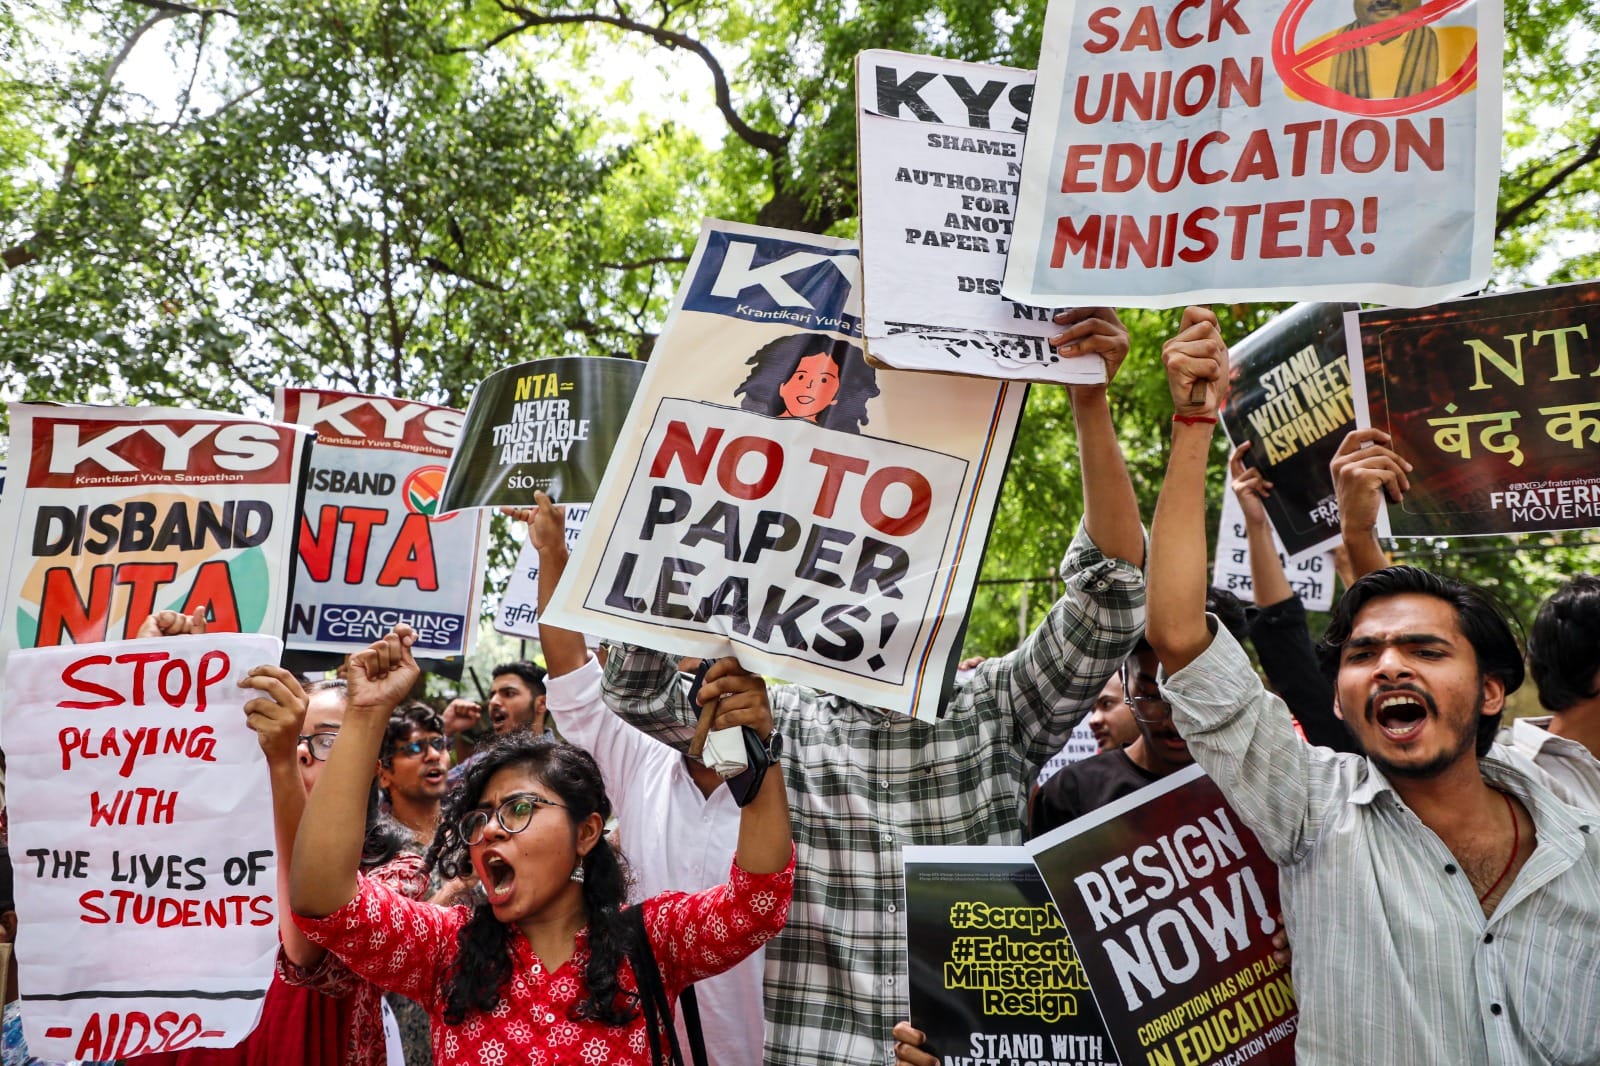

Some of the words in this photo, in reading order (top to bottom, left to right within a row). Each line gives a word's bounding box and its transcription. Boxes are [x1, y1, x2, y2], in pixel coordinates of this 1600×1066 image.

[1083, 0, 1250, 54] SACK
[1074, 56, 1264, 124] UNION
[927, 133, 1016, 157] SHAME
[1060, 118, 1444, 193] EDUCATION
[961, 195, 1010, 215] FOR
[905, 228, 989, 253] PAPER
[1049, 196, 1378, 269] MINISTER!
[957, 275, 1003, 295] DIS
[736, 304, 810, 324] Krantikari
[815, 316, 850, 329] Yuva
[1259, 344, 1321, 401] STAND
[1463, 323, 1600, 391] NT
[297, 392, 466, 448] KYS
[512, 399, 570, 423] NEVER
[1247, 387, 1303, 437] WITH
[1299, 354, 1352, 408] NEET
[49, 423, 280, 473] KYS
[317, 435, 365, 446] Krantikari
[367, 440, 391, 448] Yuva
[393, 442, 448, 455] Sangathan
[492, 419, 590, 446] TRUSTABLE
[499, 440, 573, 465] AGENCY
[1427, 402, 1525, 467] बंद
[75, 475, 138, 484] Krantikari
[141, 474, 171, 482] Yuva
[175, 474, 244, 483] Sangathan
[648, 420, 785, 500] NO
[809, 447, 933, 537] TO
[32, 500, 273, 556] DISBAND
[300, 505, 439, 591] NTA
[639, 485, 910, 600] PAPER
[35, 561, 243, 648] NTA
[323, 608, 459, 632] COACHING
[605, 552, 900, 673] LEAKS!
[328, 623, 450, 645] CENES
[57, 650, 231, 712] STOP
[58, 725, 217, 777] PLAYING
[90, 787, 178, 828] WITH
[26, 848, 90, 879] THE
[111, 850, 208, 891] LIVES
[223, 849, 274, 886] OF
[1074, 808, 1247, 931] RESIGN
[80, 890, 274, 928] STUDENTS
[952, 936, 1079, 964] #Educati
[1102, 866, 1276, 1012] NOW!
[983, 988, 1077, 1023] Resign
[1137, 991, 1214, 1047] CORRUPTION
[1210, 977, 1238, 1005] HAS
[1237, 968, 1255, 991] NO
[1175, 972, 1295, 1066] EDUCATION
[970, 1032, 1043, 1059] STAND
[1050, 1034, 1103, 1061] WITH
